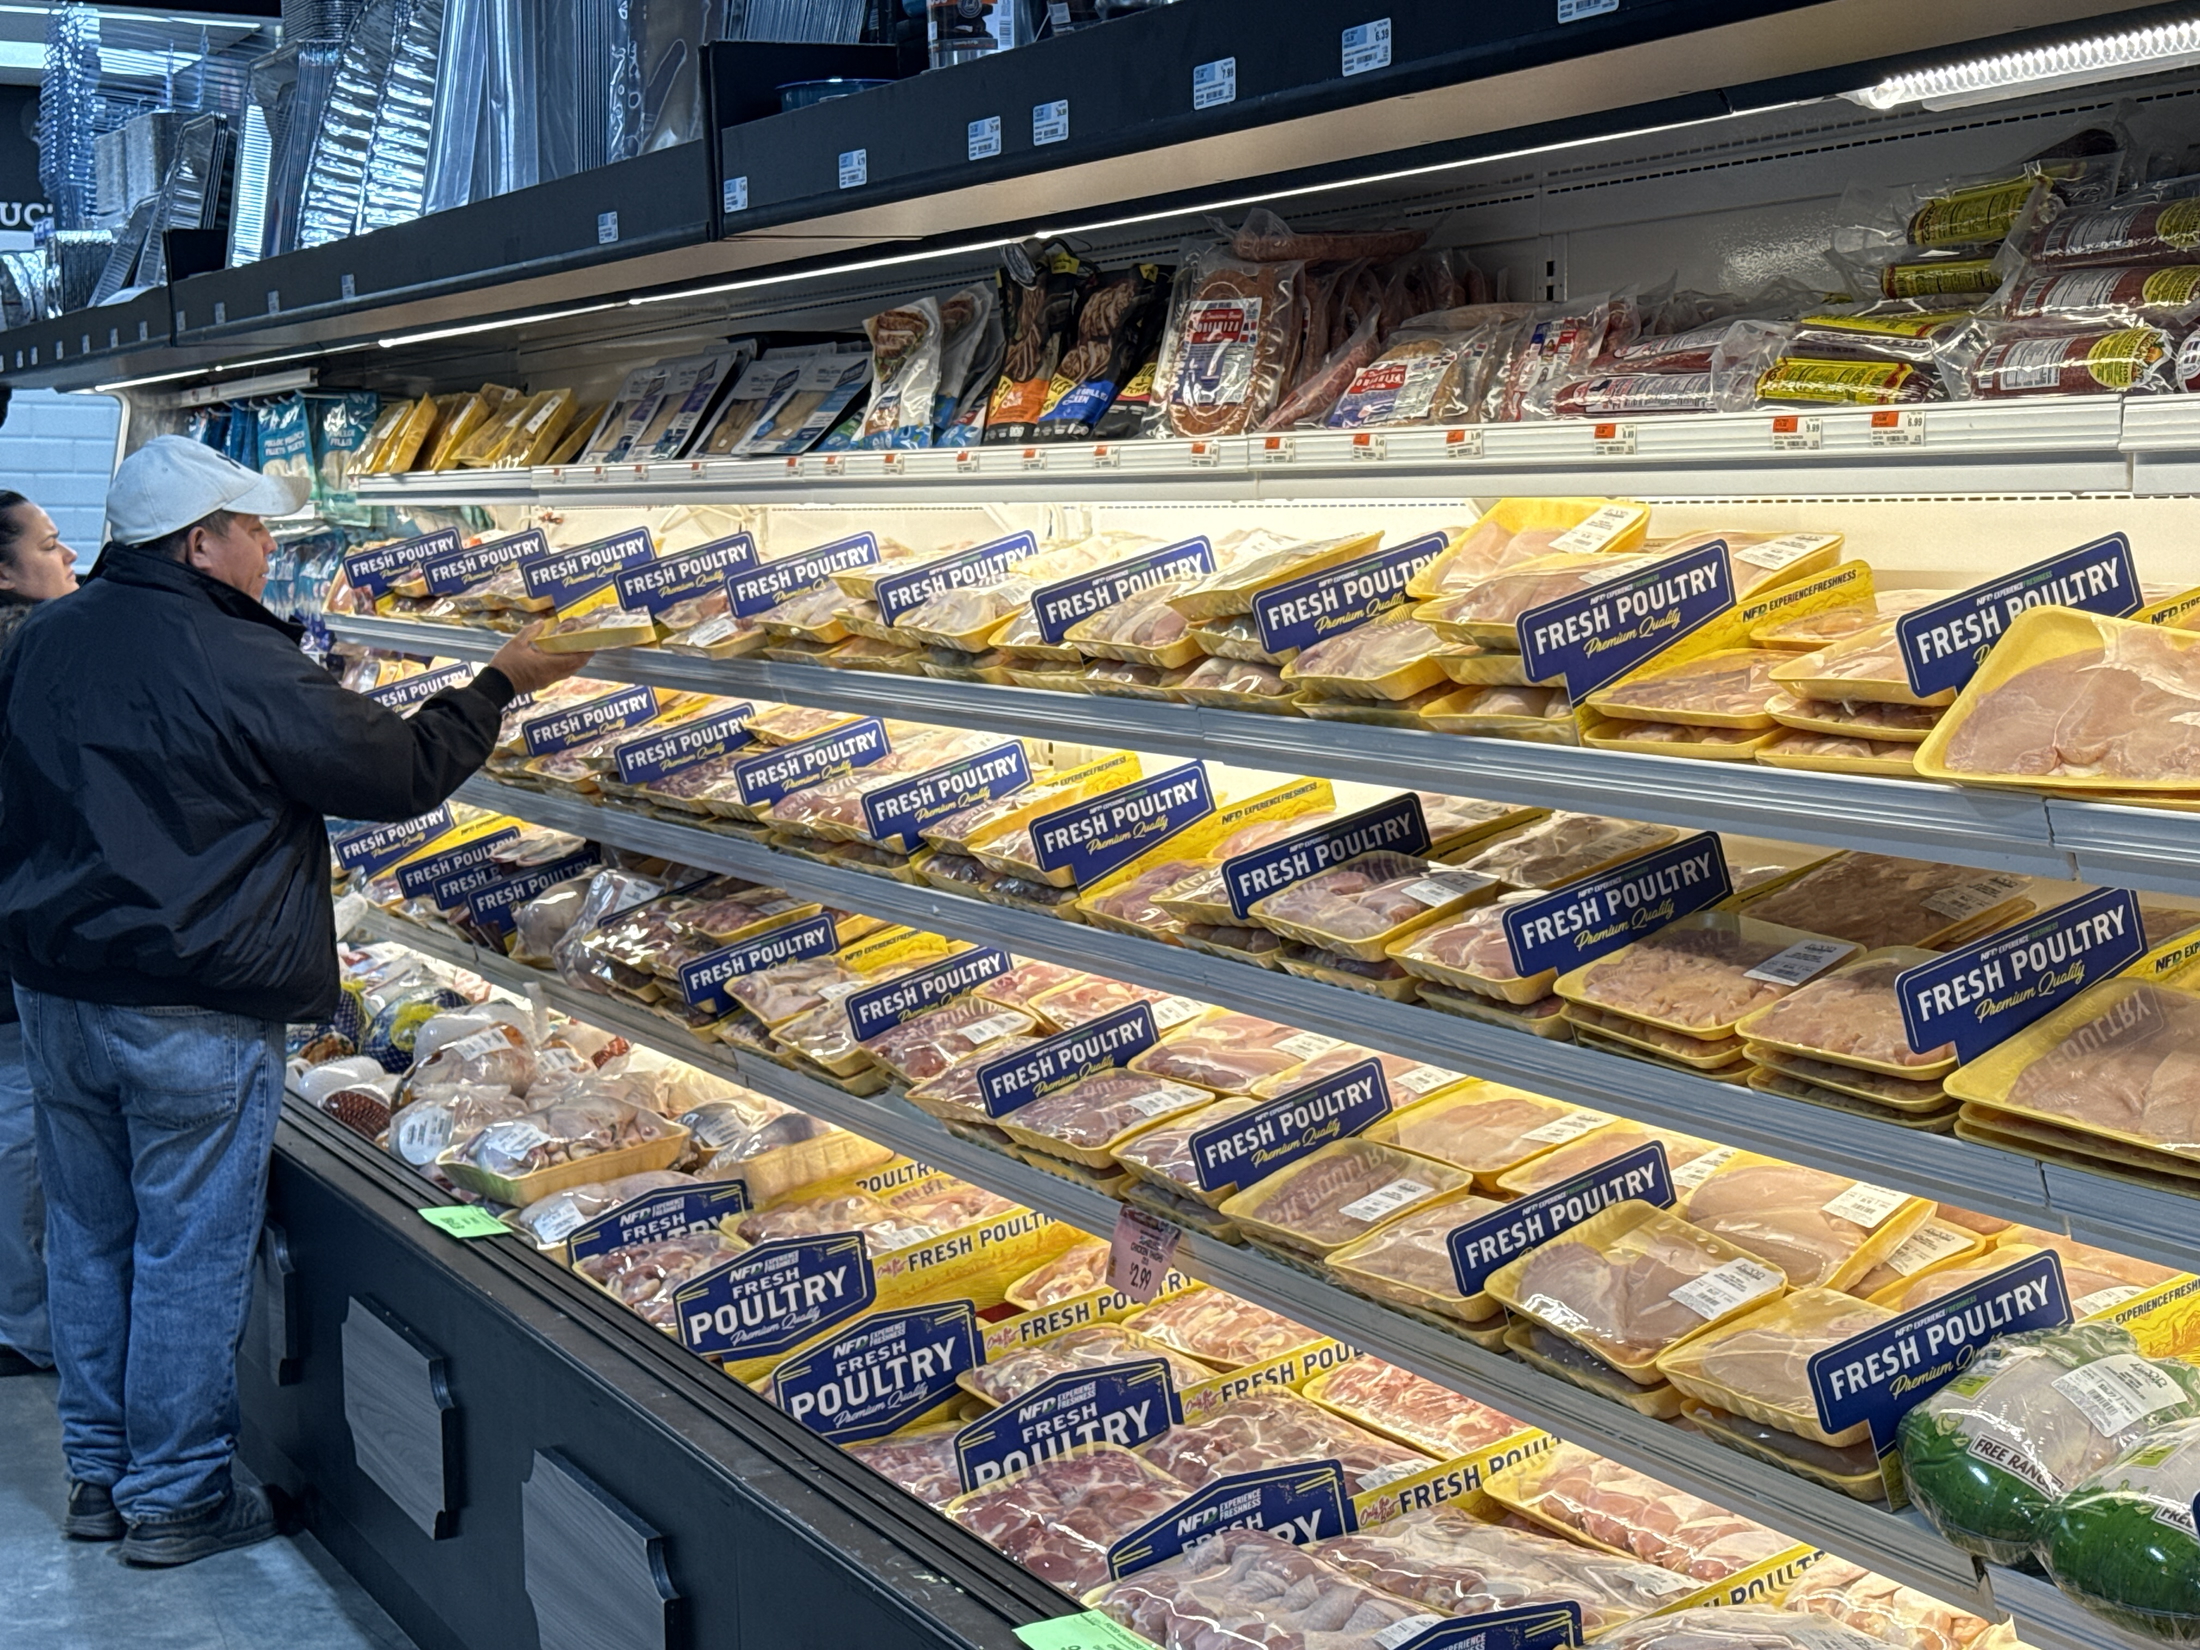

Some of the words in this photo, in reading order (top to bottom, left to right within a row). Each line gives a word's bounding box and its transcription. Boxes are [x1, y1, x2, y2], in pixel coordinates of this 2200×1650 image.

[352, 551, 400, 578] FRESH
[398, 535, 455, 564] POULTRY
[431, 555, 479, 583] FRESH
[480, 537, 541, 569] POULTRY
[531, 557, 581, 586] FRESH
[582, 536, 645, 573] POULTRY
[624, 567, 675, 597] FRESH
[681, 543, 748, 578] POULTRY
[736, 571, 792, 602] FRESH
[796, 543, 870, 583] POULTRY
[887, 574, 947, 611] FRESH
[1045, 584, 1113, 625] FRESH
[1118, 552, 1204, 602] POULTRY
[1267, 586, 1340, 632] FRESH
[1534, 604, 1612, 656] FRESH
[1615, 561, 1720, 624] POULTRY
[1915, 604, 2002, 665] FRESH
[2006, 556, 2120, 625] POULTRY
[1313, 606, 1365, 636] Premium
[1583, 628, 1638, 660] Premium
[1639, 606, 1682, 638] Quality
[1742, 603, 1768, 624] NFD
[532, 712, 582, 746] FRESH
[584, 692, 649, 730] POULTRY
[625, 739, 677, 771] FRESH
[681, 713, 750, 754] POULTRY
[745, 756, 800, 792] FRESH
[804, 729, 878, 769] POULTRY
[875, 782, 939, 823] FRESH
[940, 751, 1019, 801] POULTRY
[343, 832, 387, 860] FRESH
[388, 808, 445, 841] POULTRY
[1043, 810, 1110, 855] FRESH
[1114, 779, 1199, 831] POULTRY
[1087, 827, 1133, 856] Premium
[1133, 814, 1168, 840] Quality
[1221, 809, 1243, 826] NFD
[405, 858, 451, 888] FRESH
[1238, 853, 1311, 899] FRESH
[1315, 811, 1413, 868] POULTRY
[440, 869, 488, 899] FRESH
[476, 884, 526, 913] FRESH
[1520, 897, 1601, 950] FRESH
[1605, 851, 1712, 917] POULTRY
[1573, 920, 1631, 952] Premium
[1631, 899, 1676, 930] Quality
[690, 956, 745, 991] FRESH
[750, 926, 827, 969] POULTRY
[1917, 960, 2005, 1022] FRESH
[2009, 904, 2126, 982] POULTRY
[2155, 948, 2182, 974] NFD
[858, 985, 918, 1025] FRESH
[922, 953, 1002, 999] POULTRY
[1974, 986, 2036, 1025] Premium
[2037, 958, 2086, 998] Quality
[991, 1058, 1055, 1099] FRESH
[1060, 1017, 1145, 1071] POULTRY
[1032, 1071, 1079, 1099] Premium
[1079, 1055, 1116, 1084] Quality
[1204, 1121, 1276, 1170] FRESH
[1278, 1075, 1373, 1137] POULTRY
[1250, 1139, 1301, 1169] Premium
[1301, 1117, 1342, 1147] Quality
[620, 1206, 650, 1228] NFD
[622, 1212, 686, 1243] FRESH
[1465, 1218, 1546, 1270] FRESH
[1549, 1161, 1657, 1231] POULTRY
[729, 1263, 763, 1284] NFD
[907, 1236, 974, 1273] FRESH
[1129, 1262, 1152, 1291] $2.99
[688, 1265, 848, 1346] POULTRY
[732, 1266, 800, 1300] FRESH
[730, 1321, 781, 1346] Premium
[781, 1305, 822, 1328] Quality
[1019, 1301, 1090, 1342] FRESH
[1829, 1335, 1923, 1402] FRESH
[1925, 1274, 2051, 1357] POULTRY
[832, 1333, 869, 1360] NFD
[836, 1339, 907, 1377] FRESH
[790, 1336, 956, 1421] POULTRY
[1057, 1389, 1097, 1411] FRESHNESS
[1221, 1358, 1296, 1403] FRESH
[1889, 1358, 1955, 1401] Premium
[832, 1401, 886, 1429] Premium
[887, 1380, 929, 1409] Quality
[1018, 1396, 1057, 1425] NFD
[1057, 1381, 1097, 1401] EXPERIENCE
[1022, 1401, 1099, 1444] FRESH
[1974, 1437, 2008, 1465] FREE
[1177, 1505, 1219, 1537] NFD
[1219, 1487, 1262, 1511] EXPERIENCE
[1219, 1496, 1262, 1522] FRESHNESS
[1399, 1463, 1481, 1515] FRESH
